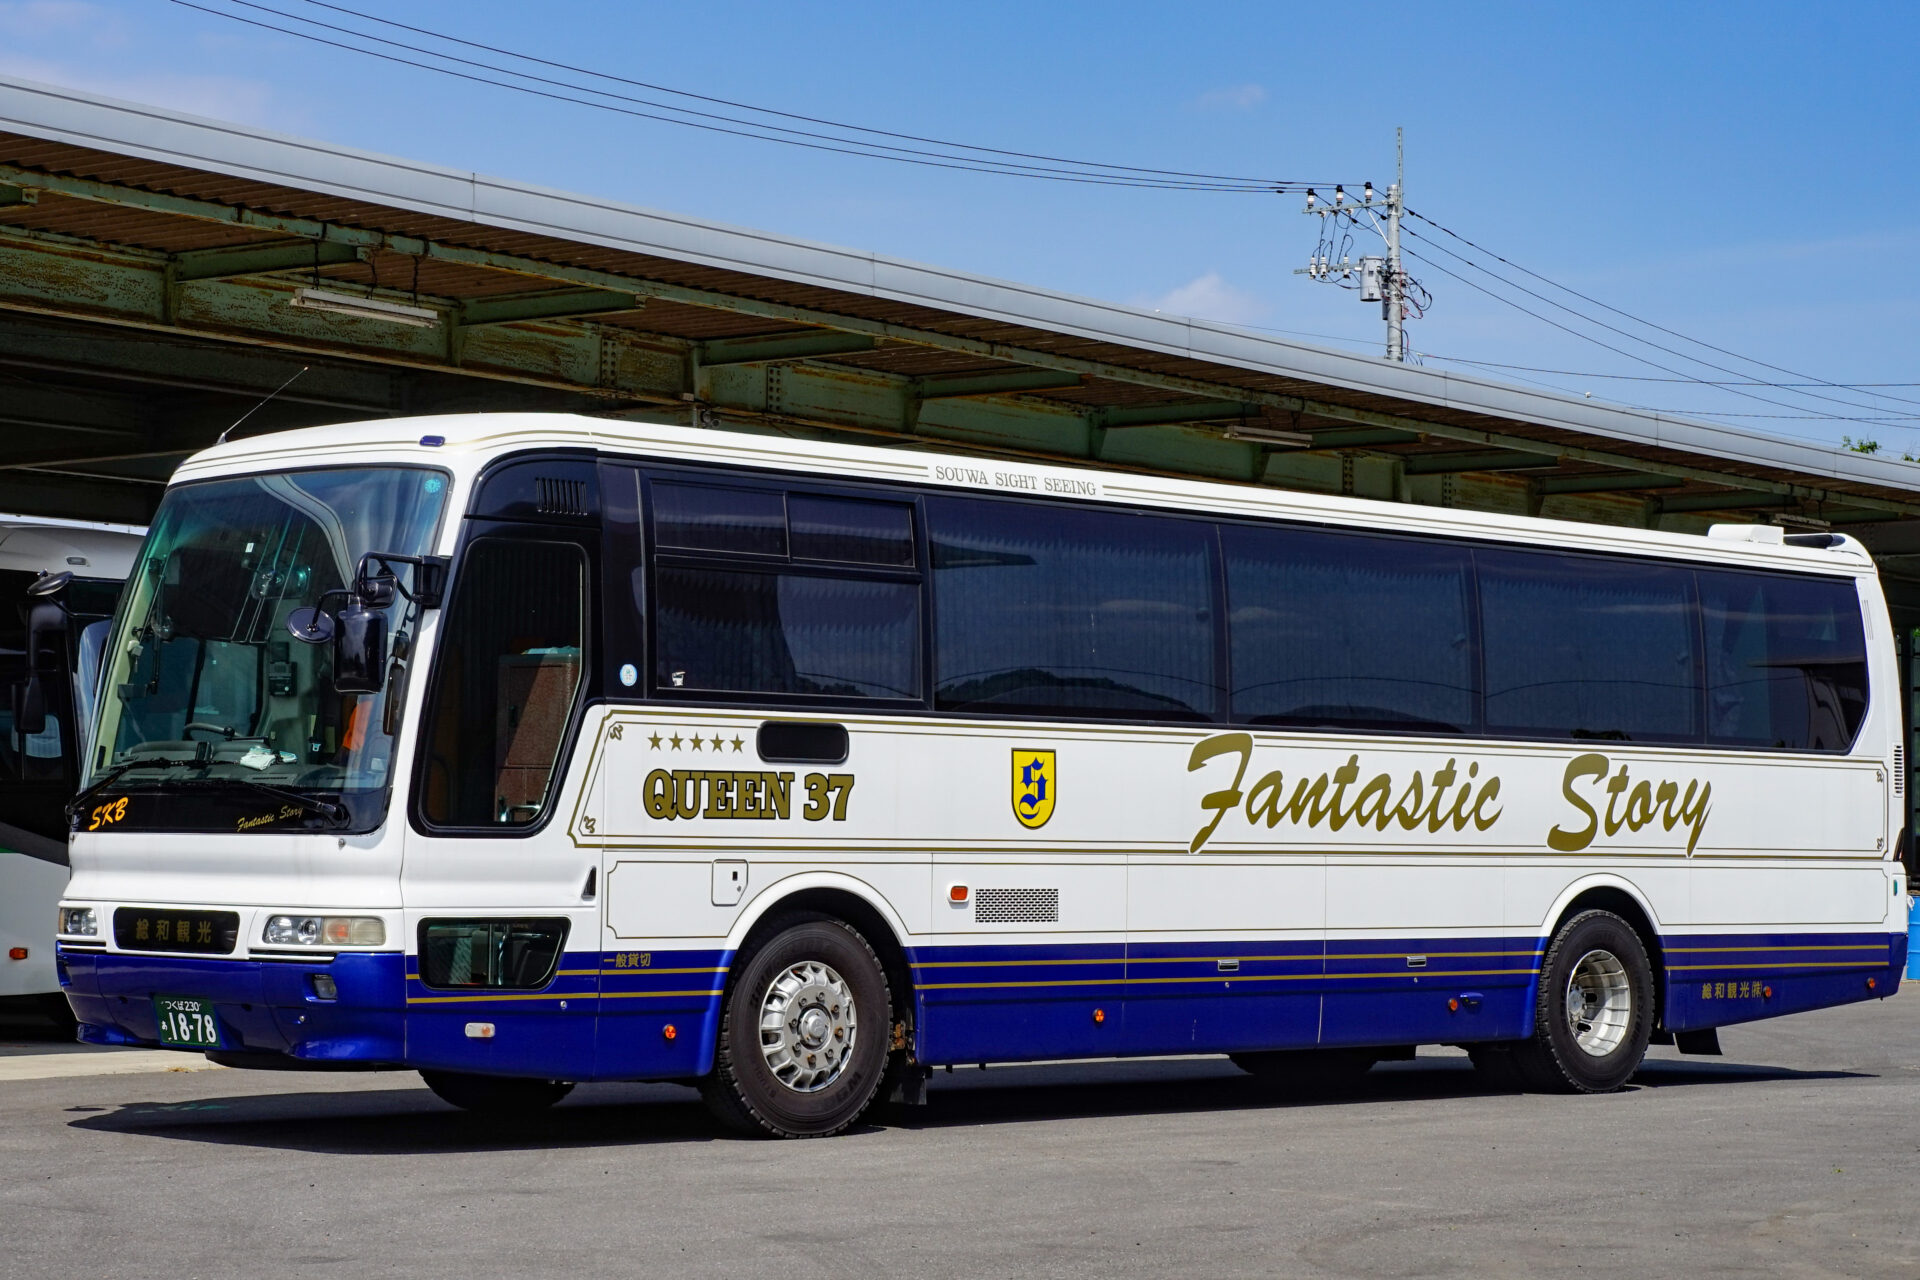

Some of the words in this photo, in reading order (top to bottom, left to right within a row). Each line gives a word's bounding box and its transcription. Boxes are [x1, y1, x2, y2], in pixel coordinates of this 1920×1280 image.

[935, 466, 989, 485] SOUWA
[995, 472, 1038, 490] SIGHT
[1044, 478, 1097, 496] SEEING
[643, 768, 795, 821] QUEEN
[803, 772, 855, 821] 37
[1187, 733, 1504, 854] Fantastic
[1547, 753, 1713, 858] Story
[88, 797, 128, 831] SKB
[237, 813, 275, 832] Fantastic
[279, 805, 304, 820] Story
[603, 952, 651, 968] 一般貸切
[168, 1012, 217, 1043] 18-78
